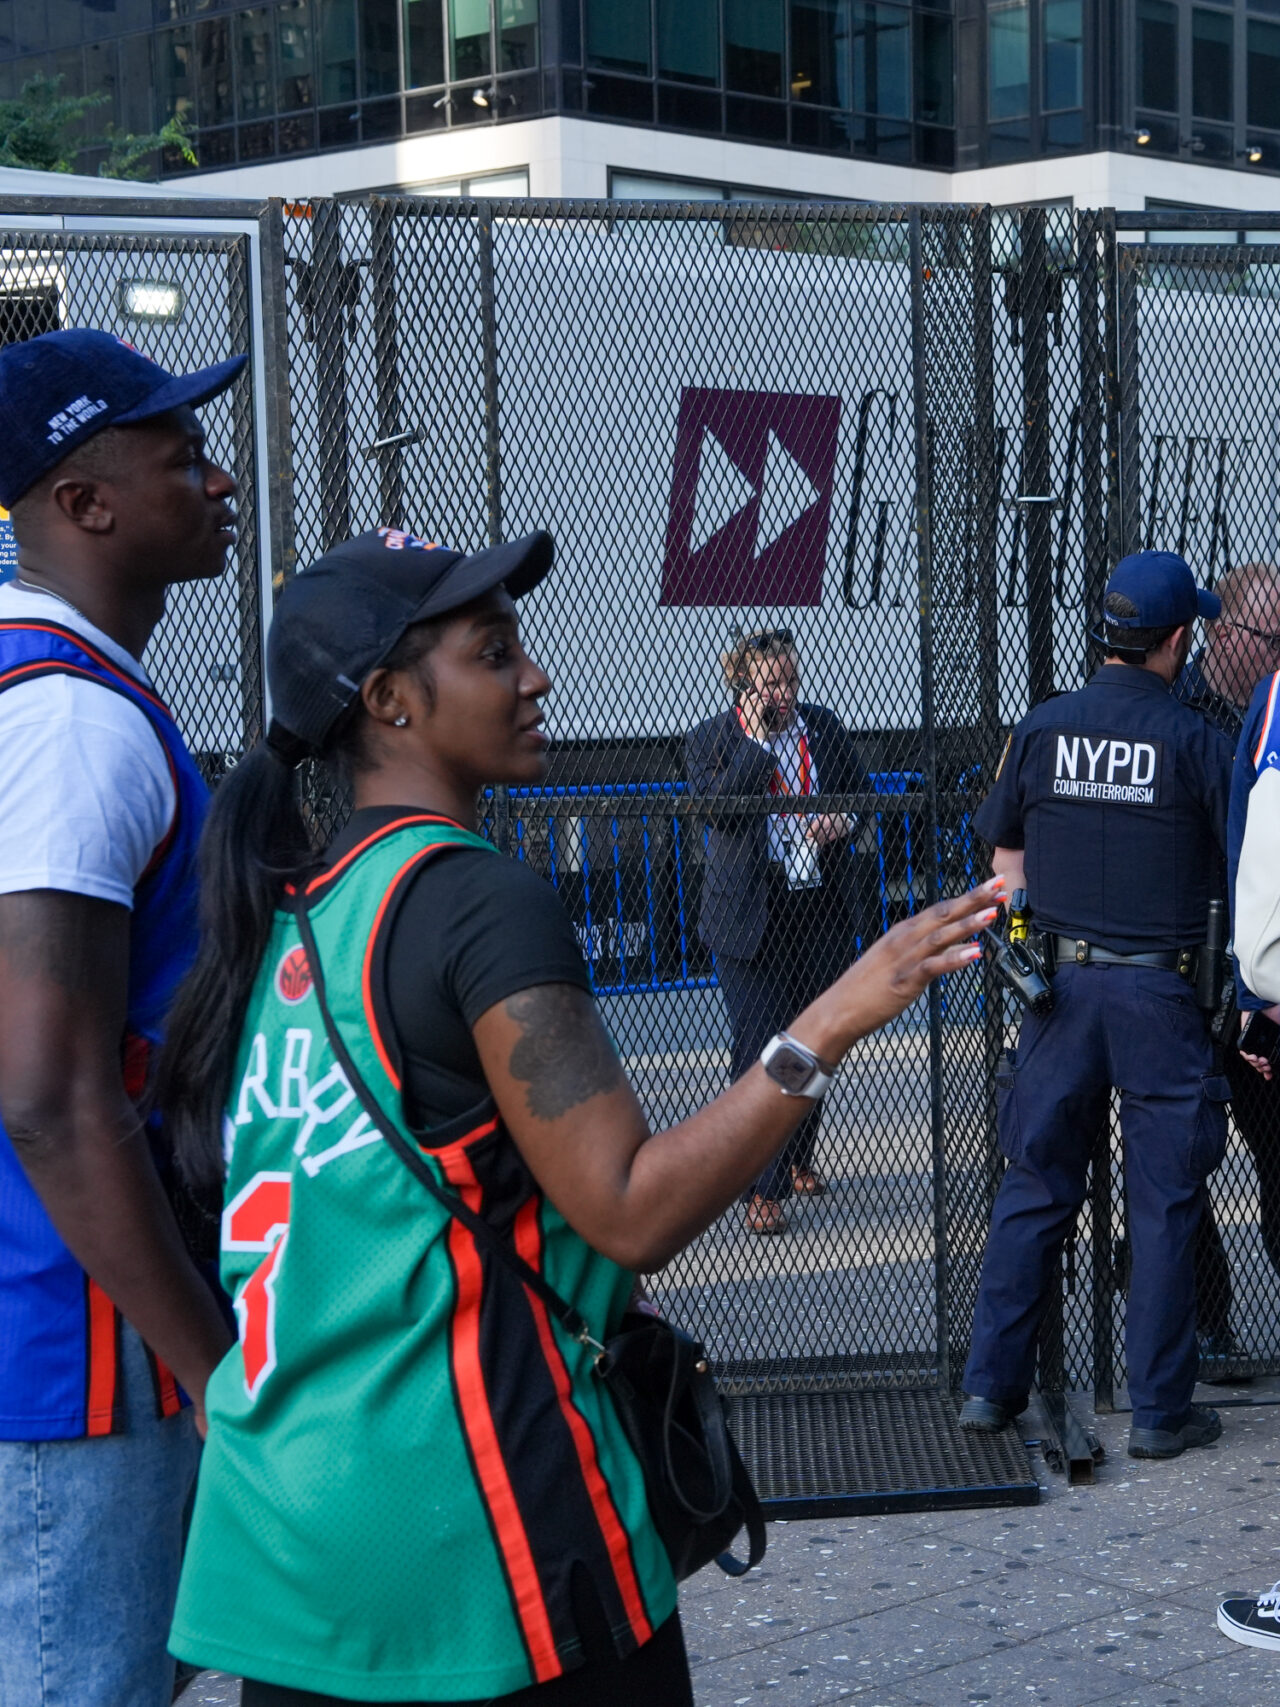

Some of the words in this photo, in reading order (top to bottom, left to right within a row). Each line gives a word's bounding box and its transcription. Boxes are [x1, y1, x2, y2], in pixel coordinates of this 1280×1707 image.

[47, 412, 70, 430] NEW
[65, 394, 90, 415] YORK
[47, 428, 62, 445] TO
[58, 417, 80, 437] THE
[77, 399, 108, 425] WORLD
[1055, 735, 1156, 785] NYPD
[1054, 779, 1153, 804] COUNTERTERRORISM
